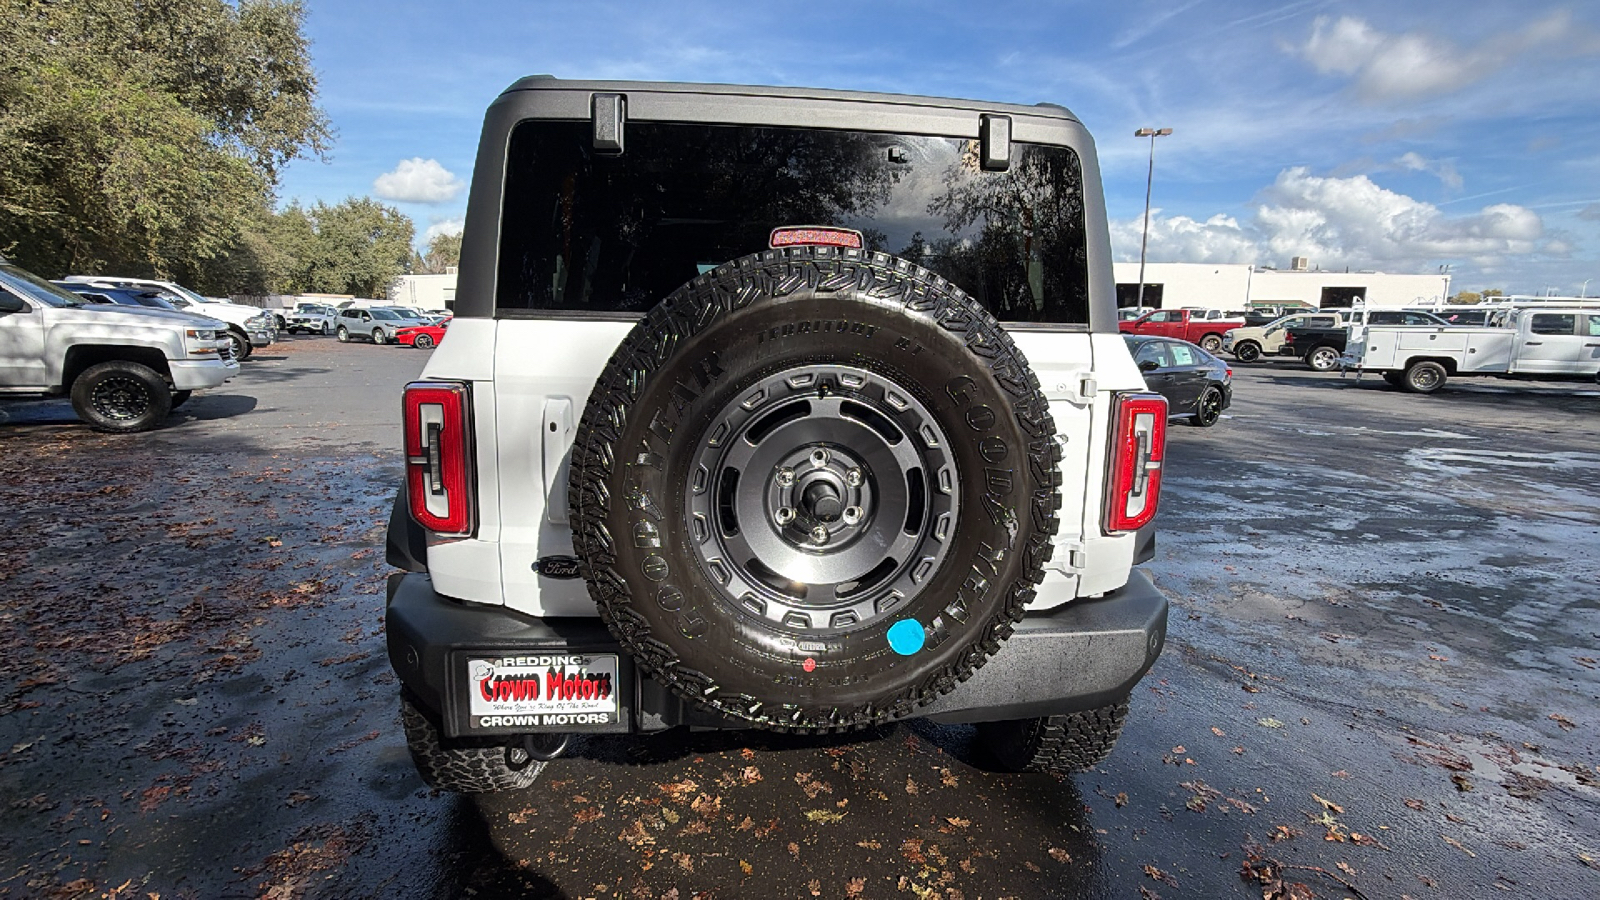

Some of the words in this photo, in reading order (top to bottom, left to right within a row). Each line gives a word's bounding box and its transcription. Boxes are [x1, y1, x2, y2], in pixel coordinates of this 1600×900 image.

[756, 319, 881, 345] TERRITORY
[544, 561, 578, 575] Ford
[503, 656, 583, 667] REDDING
[480, 671, 540, 702] Crown
[546, 665, 612, 702] Motors
[493, 703, 513, 711] Where
[538, 702, 554, 711] King
[556, 702, 566, 711] Of
[567, 702, 579, 710] The
[581, 702, 599, 710] Road
[480, 716, 539, 727] CROWN
[543, 713, 608, 725] MOTORS
